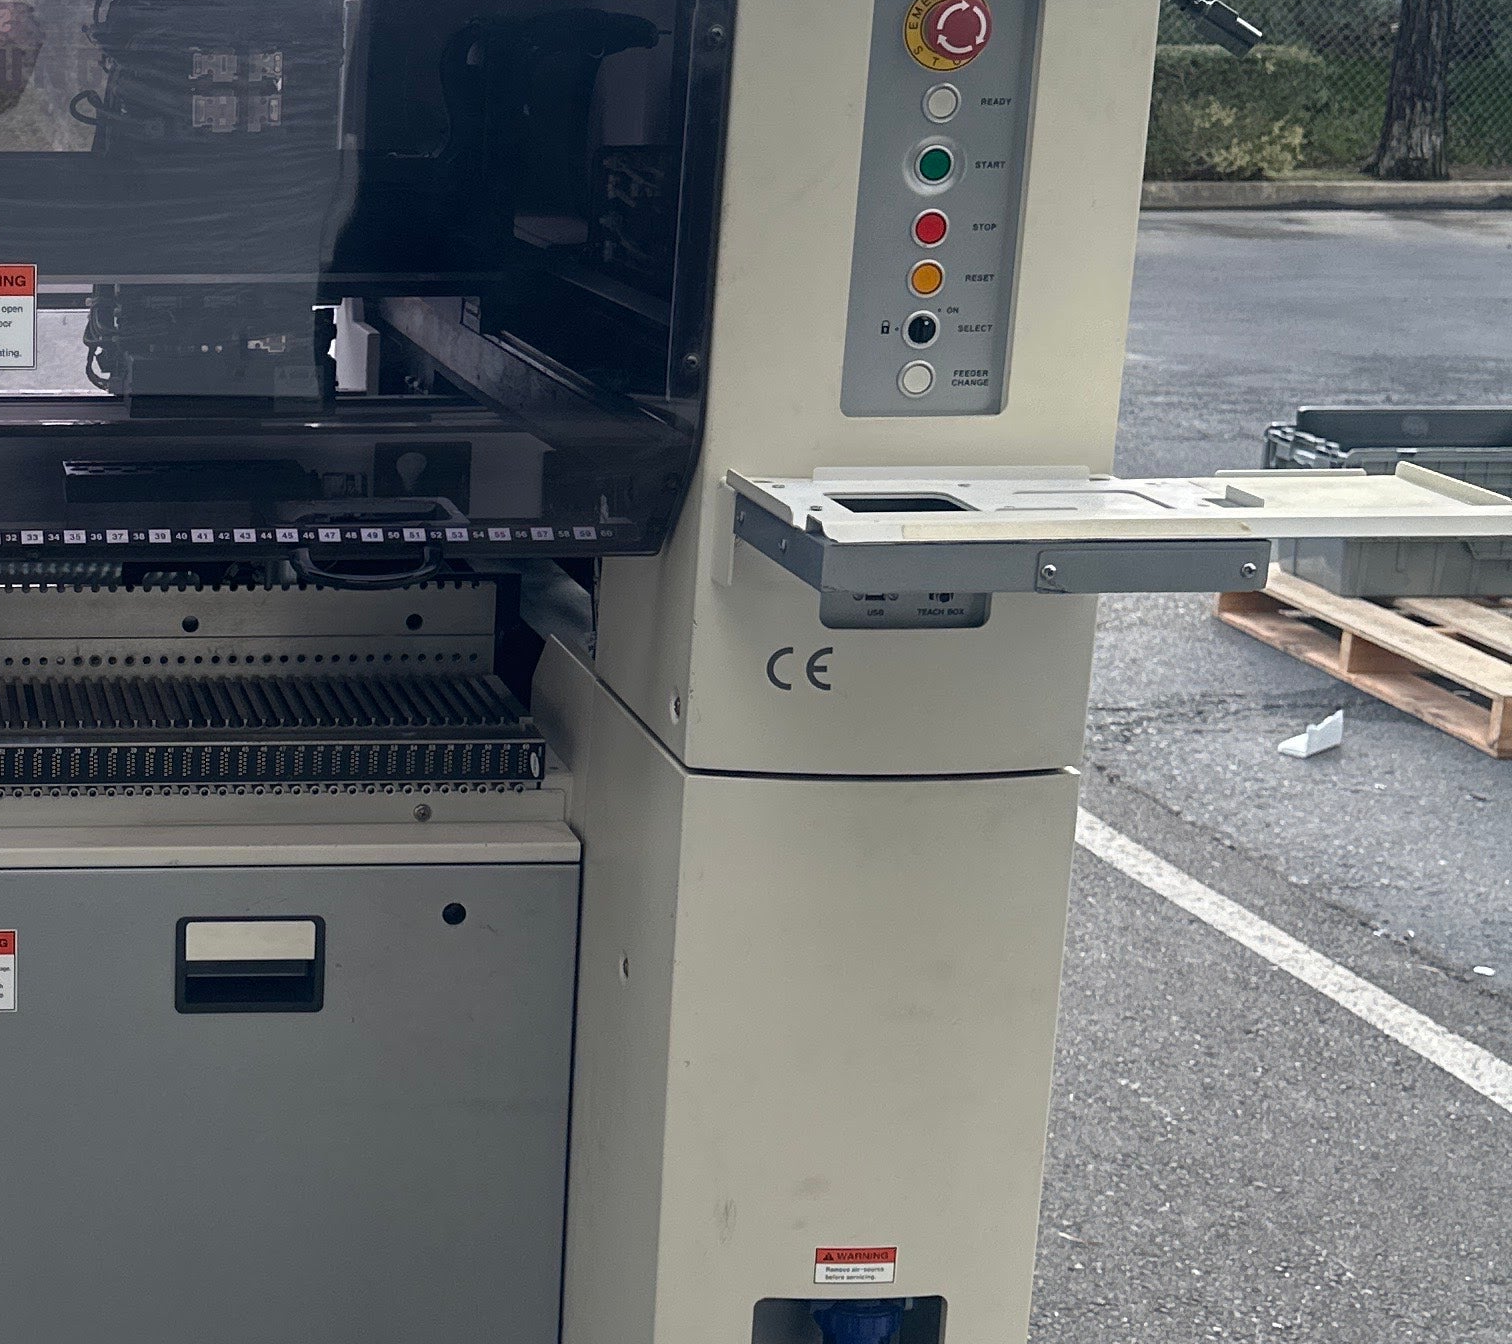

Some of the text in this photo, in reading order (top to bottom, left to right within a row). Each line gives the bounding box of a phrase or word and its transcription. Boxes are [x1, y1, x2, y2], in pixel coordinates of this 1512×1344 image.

[913, 46, 962, 66] STO
[980, 98, 1012, 106] READY
[975, 160, 1006, 169] START
[972, 223, 997, 231] STOP
[965, 274, 995, 282] RESET
[2, 306, 23, 315] open
[766, 646, 833, 691] CE
[837, 1252, 888, 1260] WARNING
